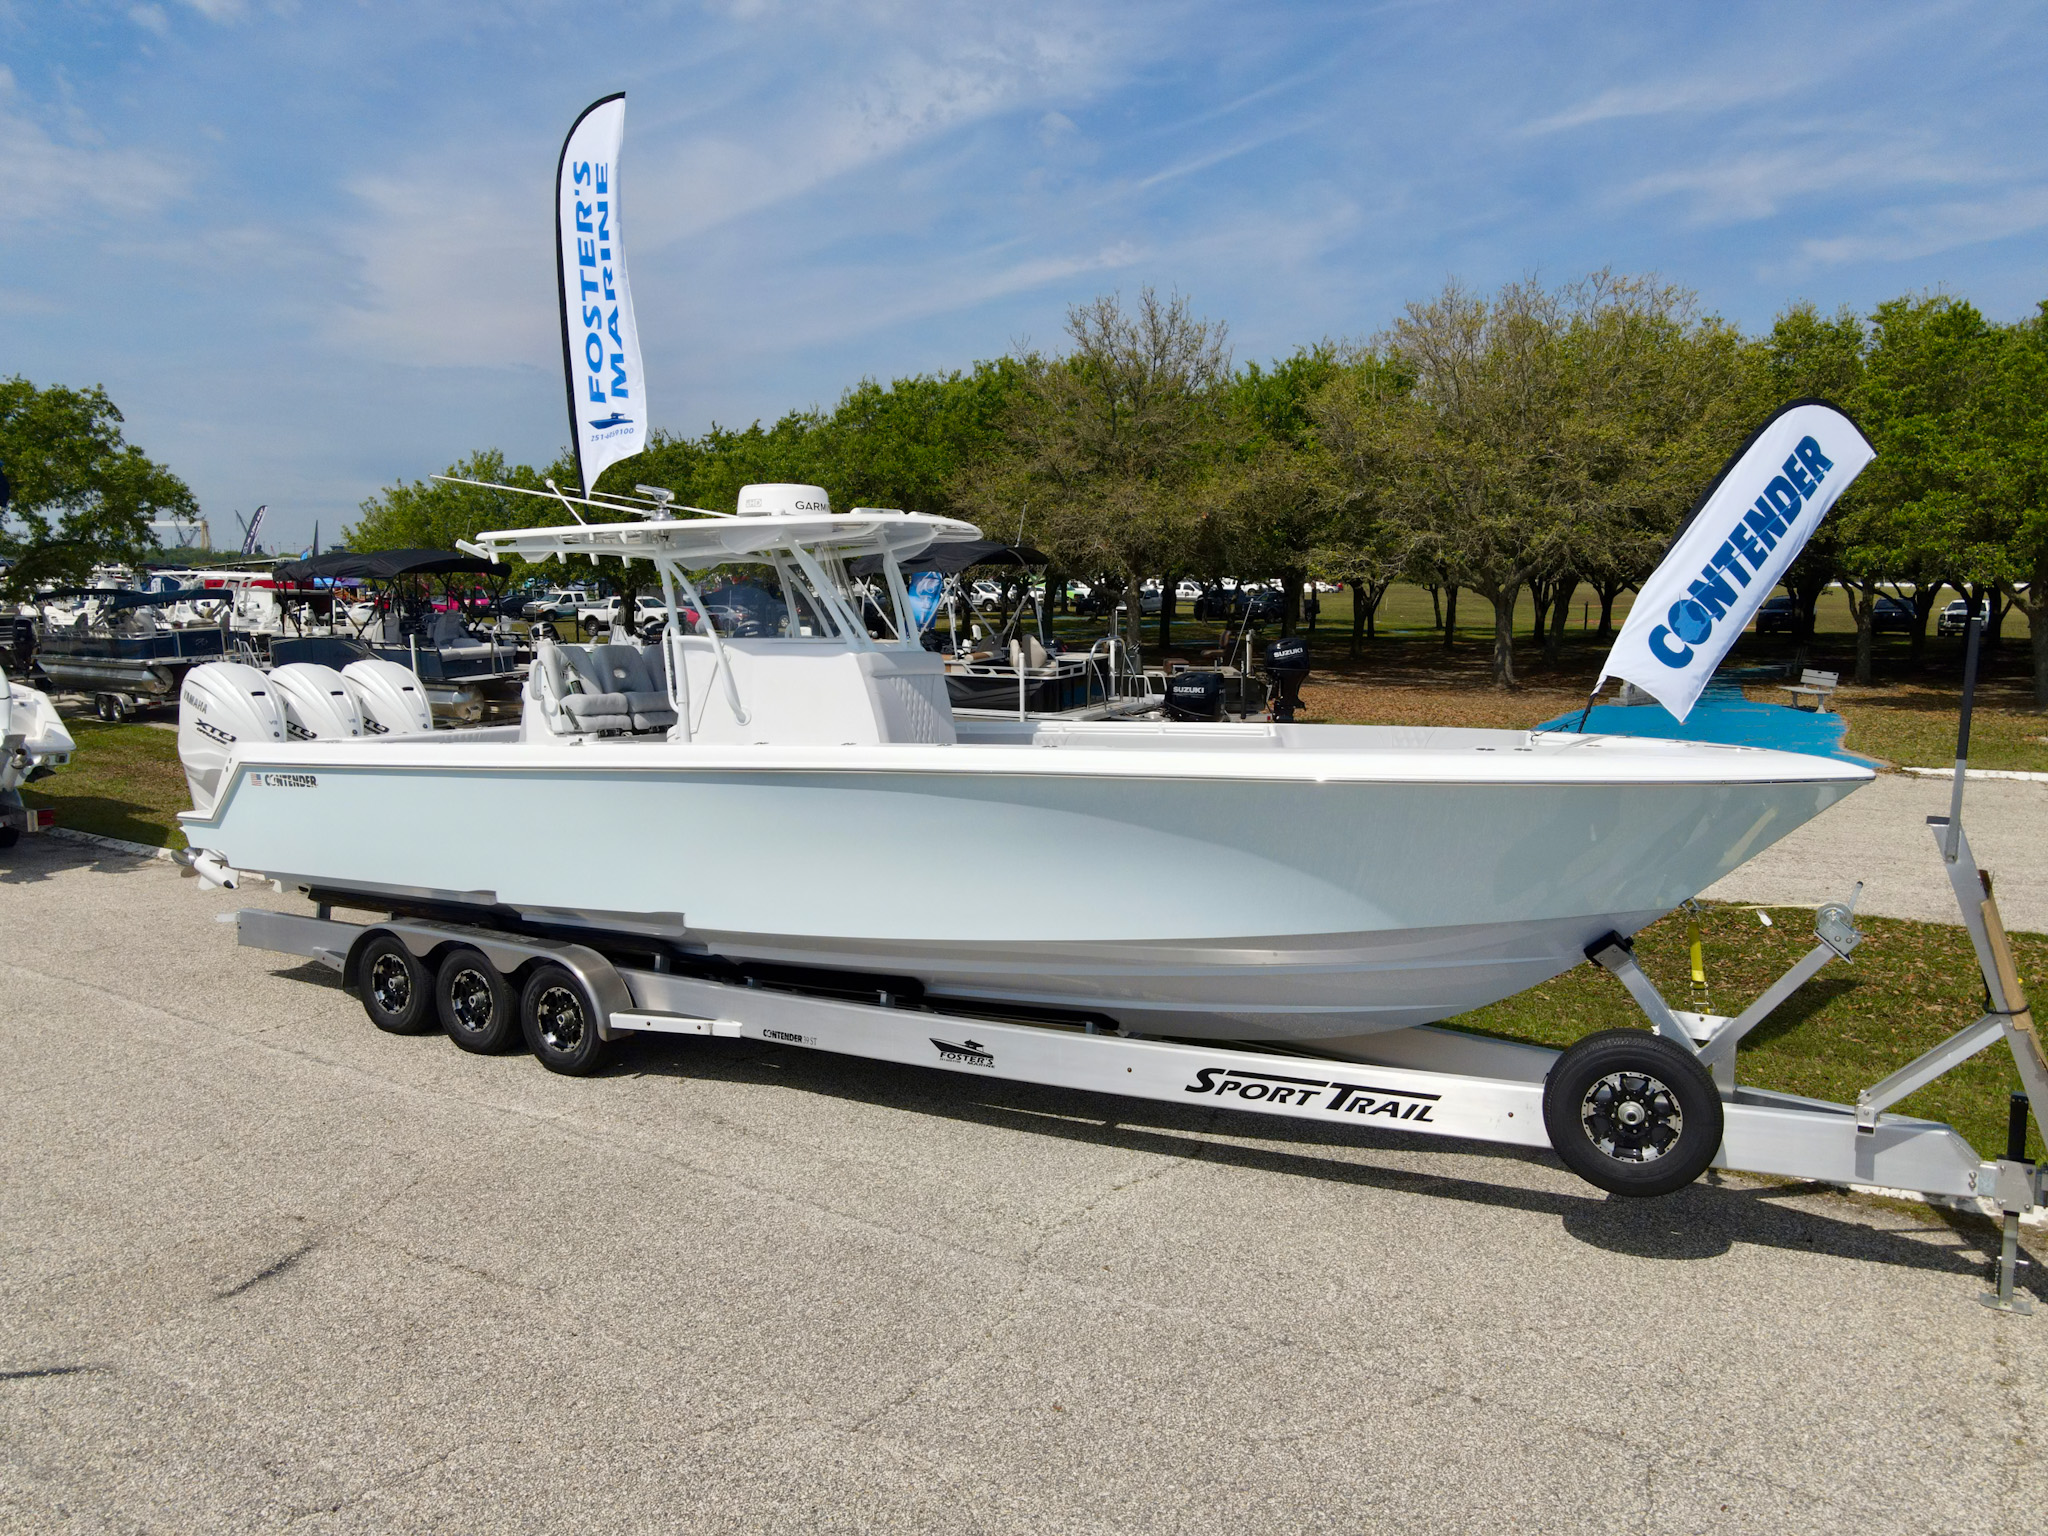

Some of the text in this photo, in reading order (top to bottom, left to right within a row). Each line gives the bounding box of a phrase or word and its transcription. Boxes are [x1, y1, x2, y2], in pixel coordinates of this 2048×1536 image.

[573, 161, 607, 403] FOSTER'S
[595, 162, 629, 399] MARINE
[1648, 435, 1835, 669] CONTENDER
[1273, 647, 1303, 658] SUZUKI
[1173, 686, 1205, 694] SUZUKI
[183, 689, 208, 714] YAMAHA
[265, 774, 317, 788] CONTENDER
[763, 1029, 802, 1043] CONTENDER
[940, 1051, 994, 1065] FOSTER'S
[1185, 1068, 1442, 1123] SPORT TRAIL
